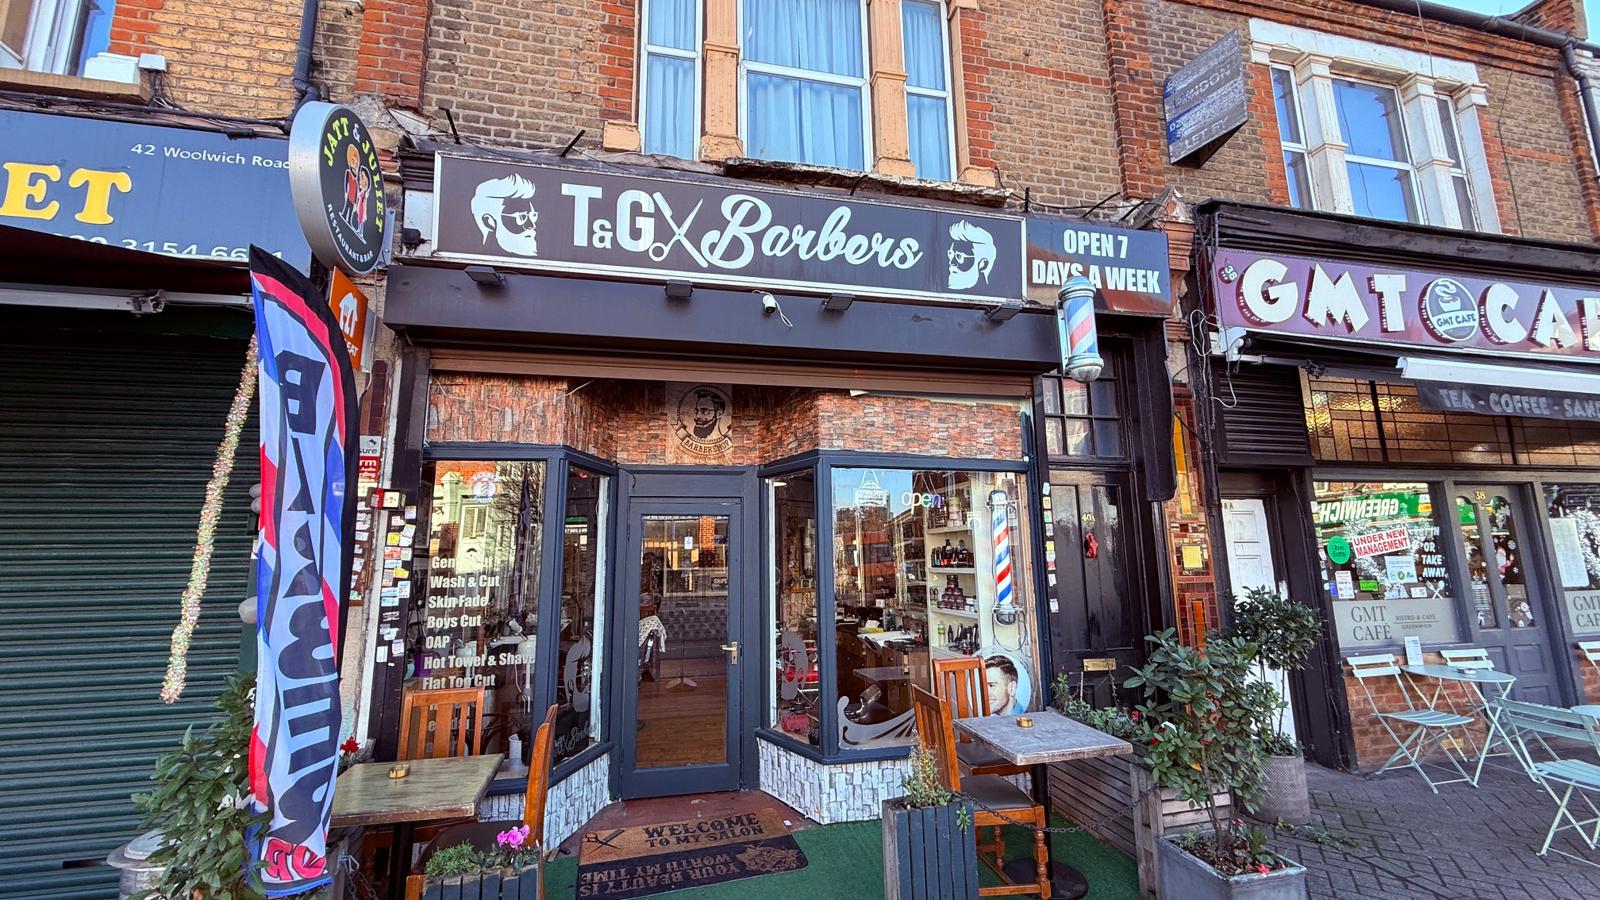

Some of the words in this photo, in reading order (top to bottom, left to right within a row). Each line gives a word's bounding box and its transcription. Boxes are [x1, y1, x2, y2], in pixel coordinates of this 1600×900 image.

[130, 143, 156, 156] 42
[163, 146, 246, 165] Woolwich
[324, 117, 349, 167] JATT
[352, 123, 361, 143] &
[361, 140, 384, 233] JULIET
[328, 203, 359, 262] RESTAURANT
[703, 193, 923, 270] Barbers
[1063, 229, 1114, 257] OPEN
[1117, 235, 1129, 259] 7
[1088, 264, 1102, 289] A
[1105, 266, 1161, 294] WEEK
[1225, 265, 1237, 281] 38
[1240, 259, 1407, 333] GMT
[1436, 317, 1454, 327] GMT
[1439, 389, 1475, 409] TEA
[1489, 392, 1550, 415] COFFEE
[684, 439, 732, 454] BARBERSHOP
[901, 491, 942, 514] open
[1475, 491, 1487, 501] 38
[1354, 534, 1384, 546] UNDER
[1386, 528, 1406, 540] NEW
[1356, 536, 1409, 557] MANAGEMENT
[1423, 541, 1436, 553] OR
[1421, 554, 1443, 566] TAKE
[430, 575, 466, 588] Wash
[467, 576, 477, 588] &
[479, 574, 500, 588] Cut
[1422, 567, 1446, 578] AWAY
[458, 594, 489, 608] Fade
[427, 615, 458, 630] Boys
[460, 614, 481, 628] Cut
[1351, 605, 1386, 623] GMT
[1353, 623, 1393, 641] CAFÉ
[425, 635, 450, 649] OAP
[424, 656, 446, 670] Hot
[448, 653, 486, 668] Towel
[487, 654, 497, 666] &
[499, 652, 536, 666] Shave
[422, 676, 446, 690] Flat
[473, 673, 496, 687] Cut
[642, 812, 760, 839] WELCOME
[646, 837, 670, 848] TO
[676, 834, 702, 846] MY
[706, 824, 764, 842] SALON
[640, 863, 663, 875] MY
[667, 853, 733, 872] WORTH
[689, 862, 741, 880] YOUR
[580, 868, 634, 886] TIME
[604, 869, 683, 894] BEAUTY
[579, 883, 599, 897] IS
